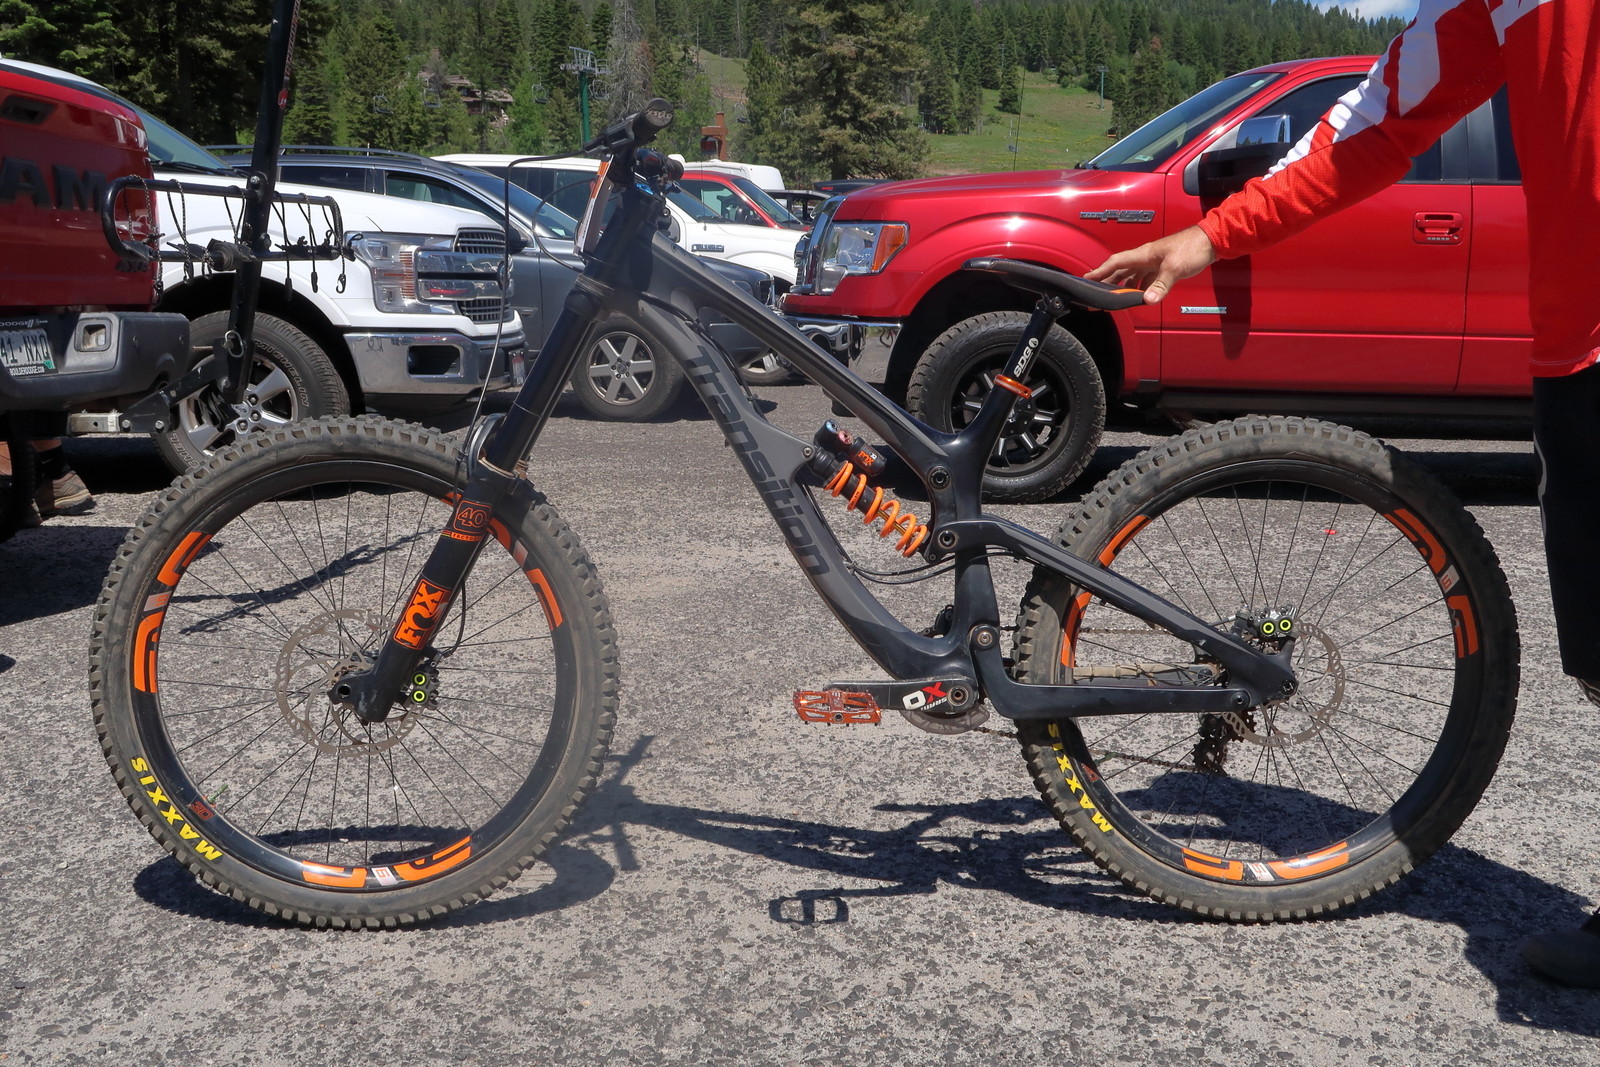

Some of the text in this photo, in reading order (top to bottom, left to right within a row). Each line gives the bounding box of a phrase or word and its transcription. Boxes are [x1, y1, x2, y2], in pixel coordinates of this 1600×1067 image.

[254, 338, 310, 407] MICHELIN
[1013, 346, 1032, 378] SDG
[686, 343, 832, 575] Transition
[458, 507, 487, 528] 40
[397, 583, 445, 648] FOX
[131, 757, 222, 862] MAXXIS
[1048, 722, 1114, 834] MAXXIS
